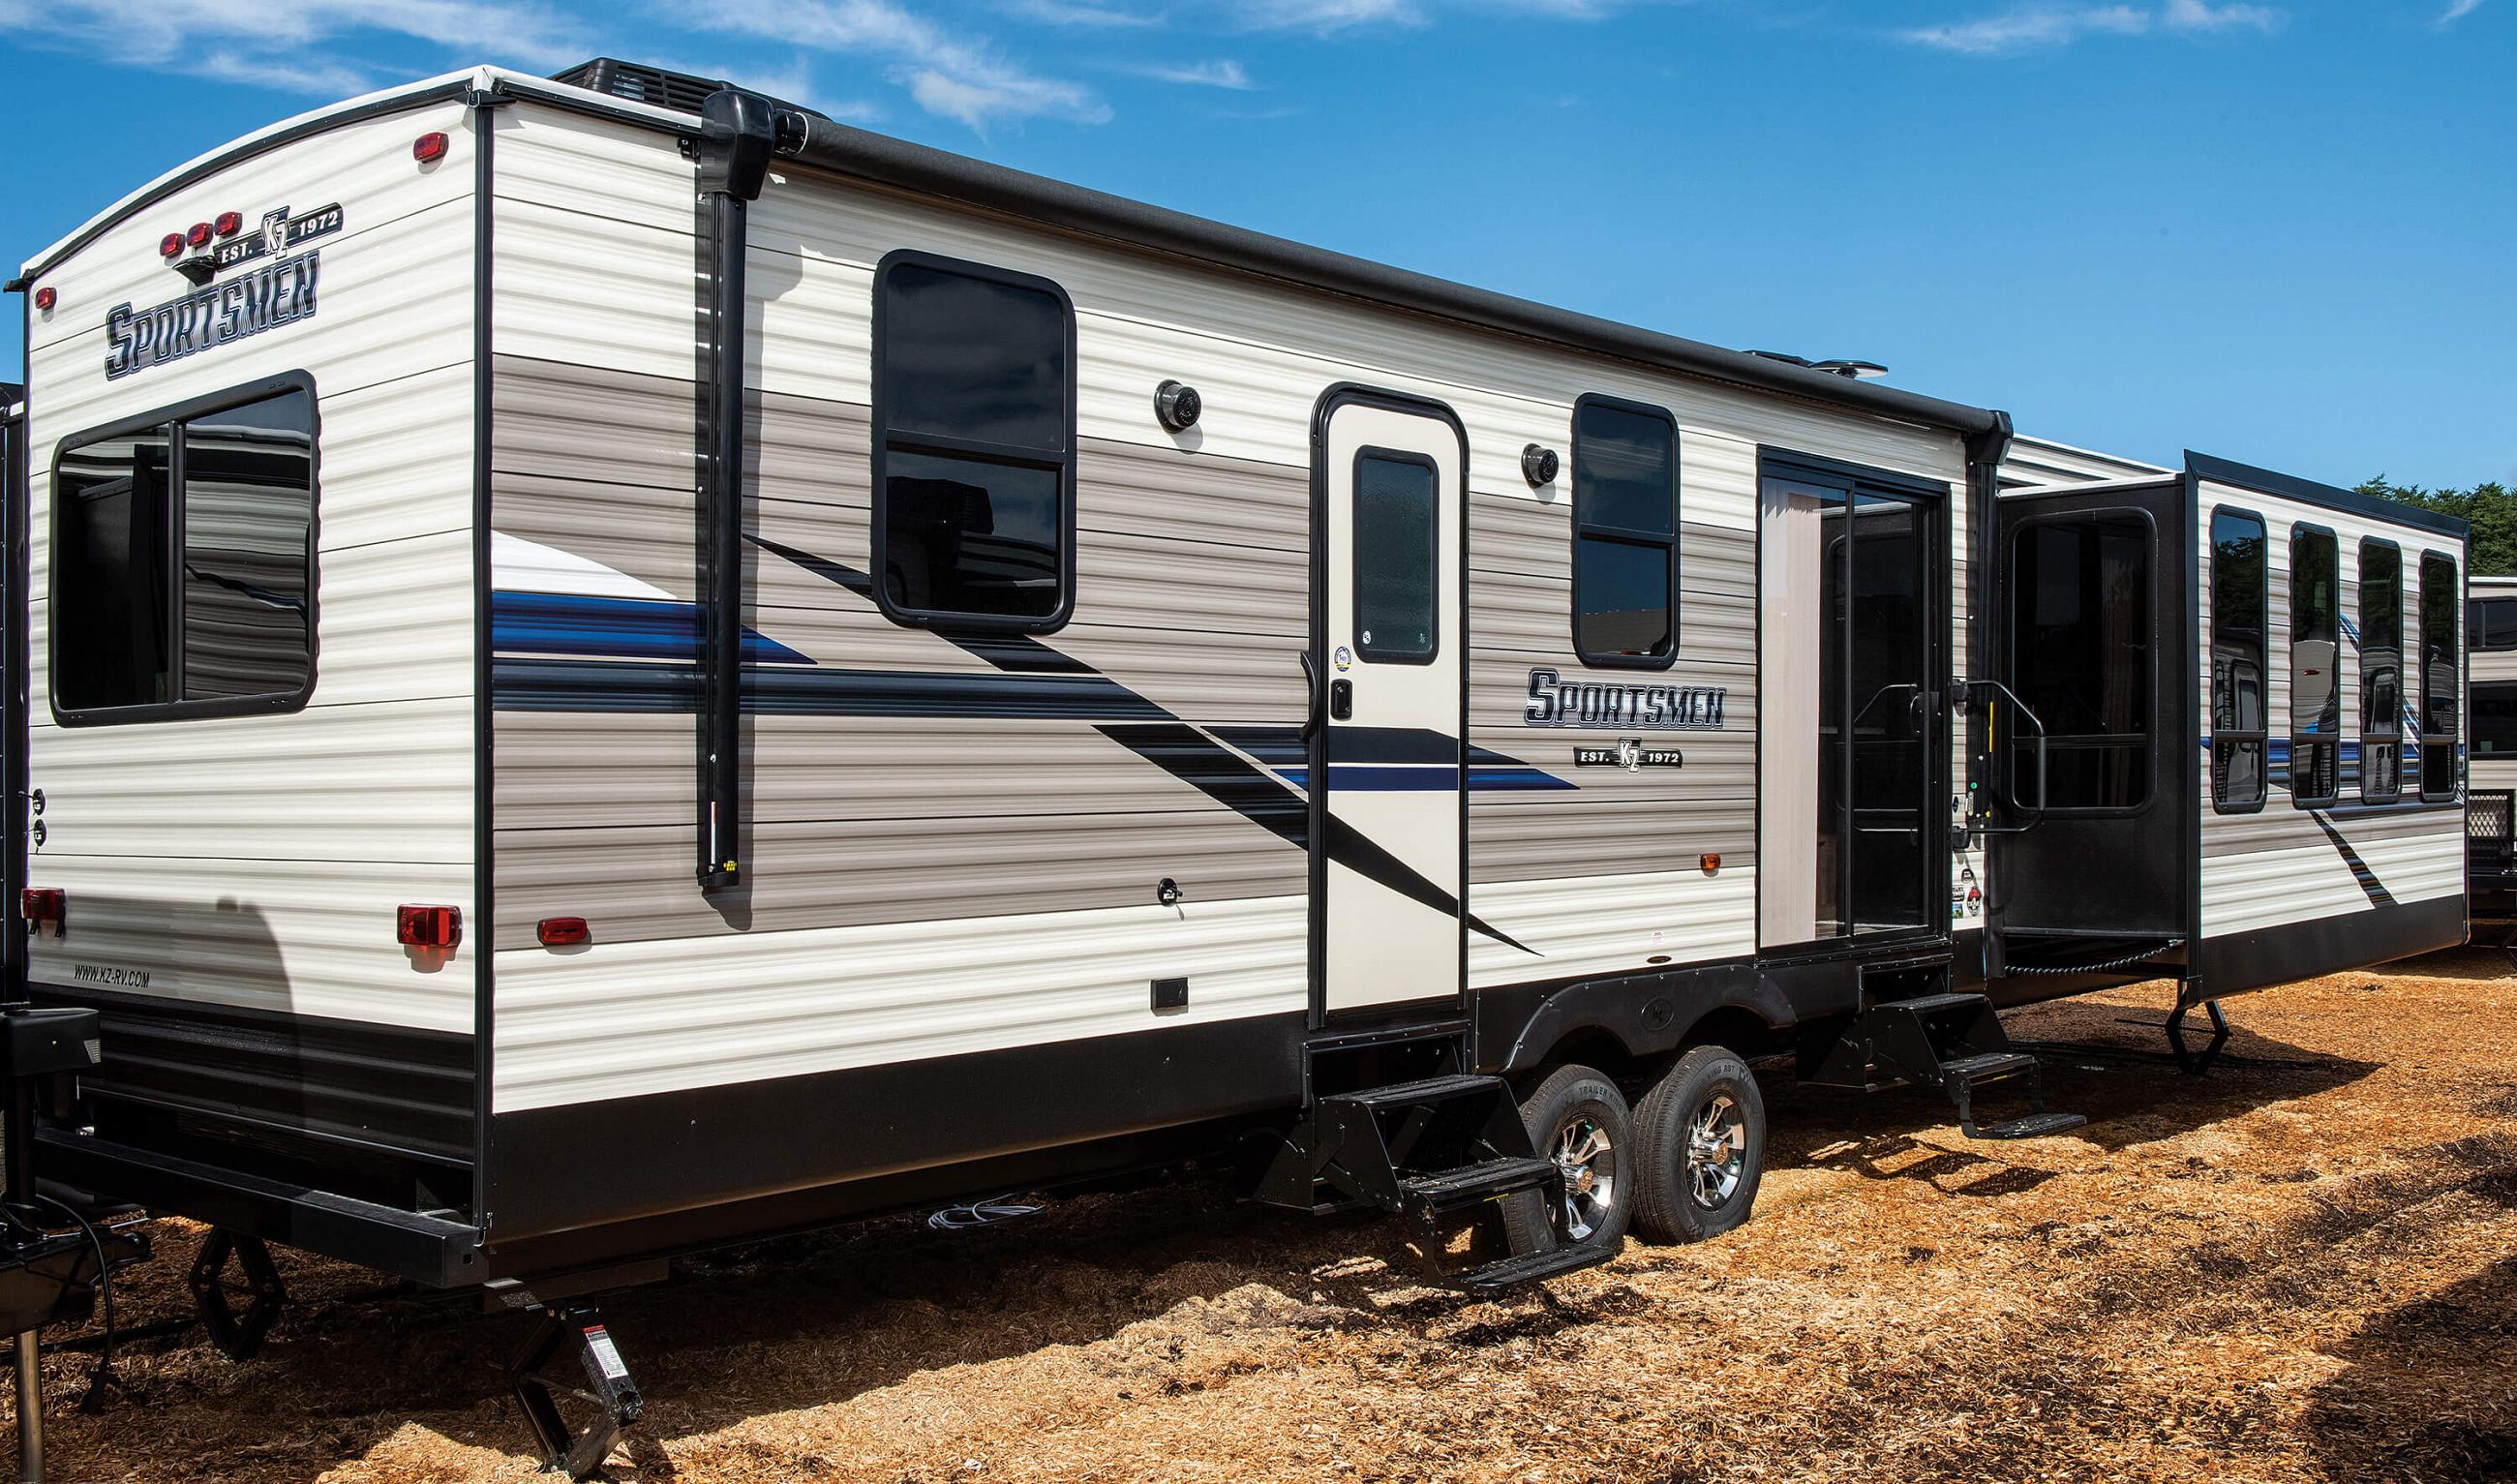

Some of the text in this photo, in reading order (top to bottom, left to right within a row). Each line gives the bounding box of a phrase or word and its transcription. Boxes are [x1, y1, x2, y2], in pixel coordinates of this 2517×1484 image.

[221, 210, 339, 263] EST. KZ 1972
[105, 250, 322, 381] SPORTSMEN
[1524, 666, 1727, 729] SPORTSMEN
[1580, 741, 1680, 772] EST. KZ 1972
[74, 963, 150, 988] WWW.KZ-RV.COM
[1578, 1084, 1609, 1099] TRAILER
